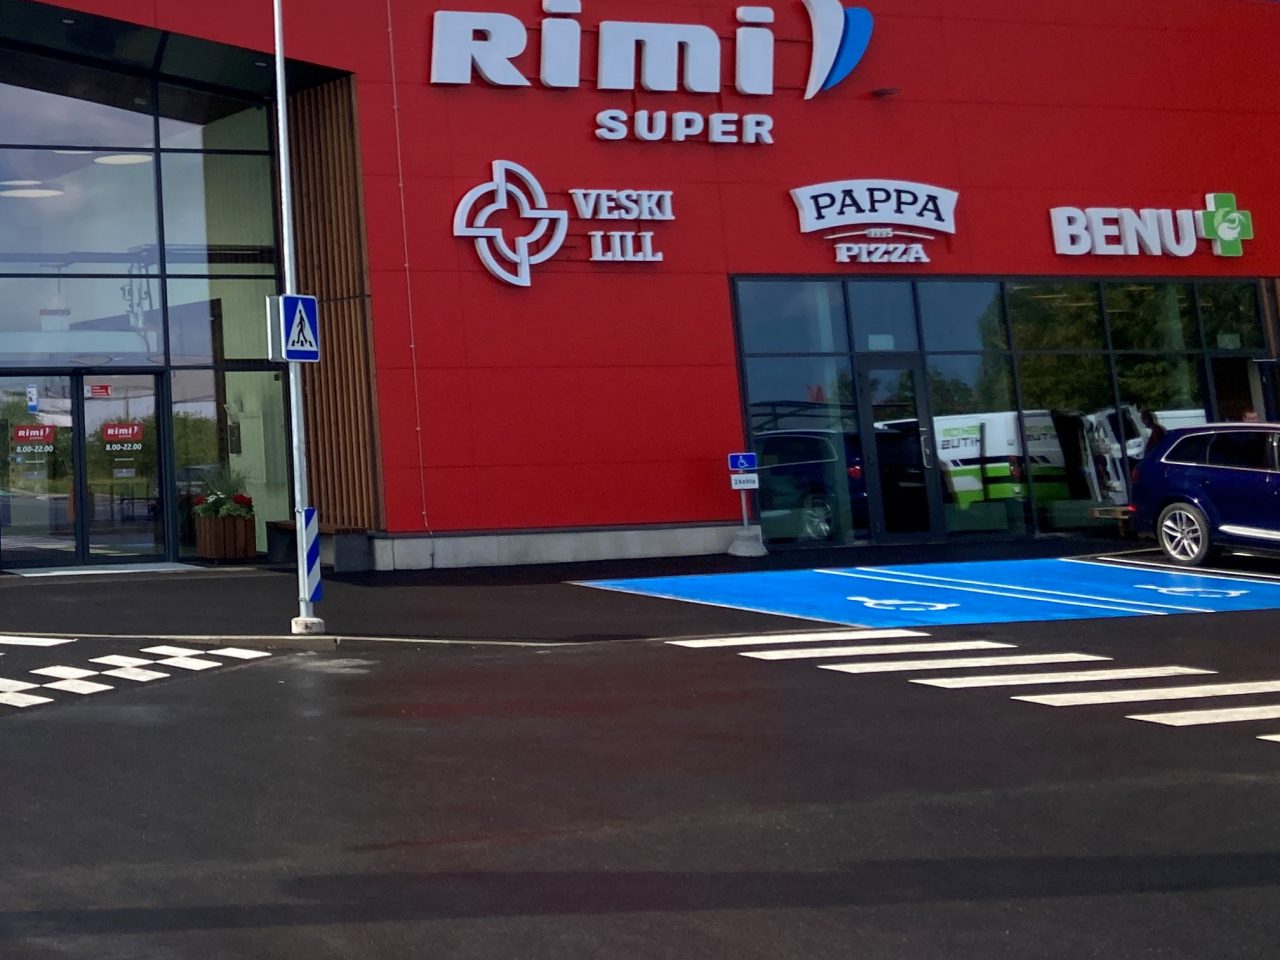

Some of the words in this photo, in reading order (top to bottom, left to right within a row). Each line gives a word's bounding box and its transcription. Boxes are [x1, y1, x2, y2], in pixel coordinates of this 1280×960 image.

[595, 109, 774, 144] SUPER
[568, 189, 676, 220] VESKI
[810, 187, 946, 223] PAPPA
[587, 231, 664, 262] LILL
[1049, 206, 1197, 257] BENU
[833, 243, 932, 263] PIZZA
